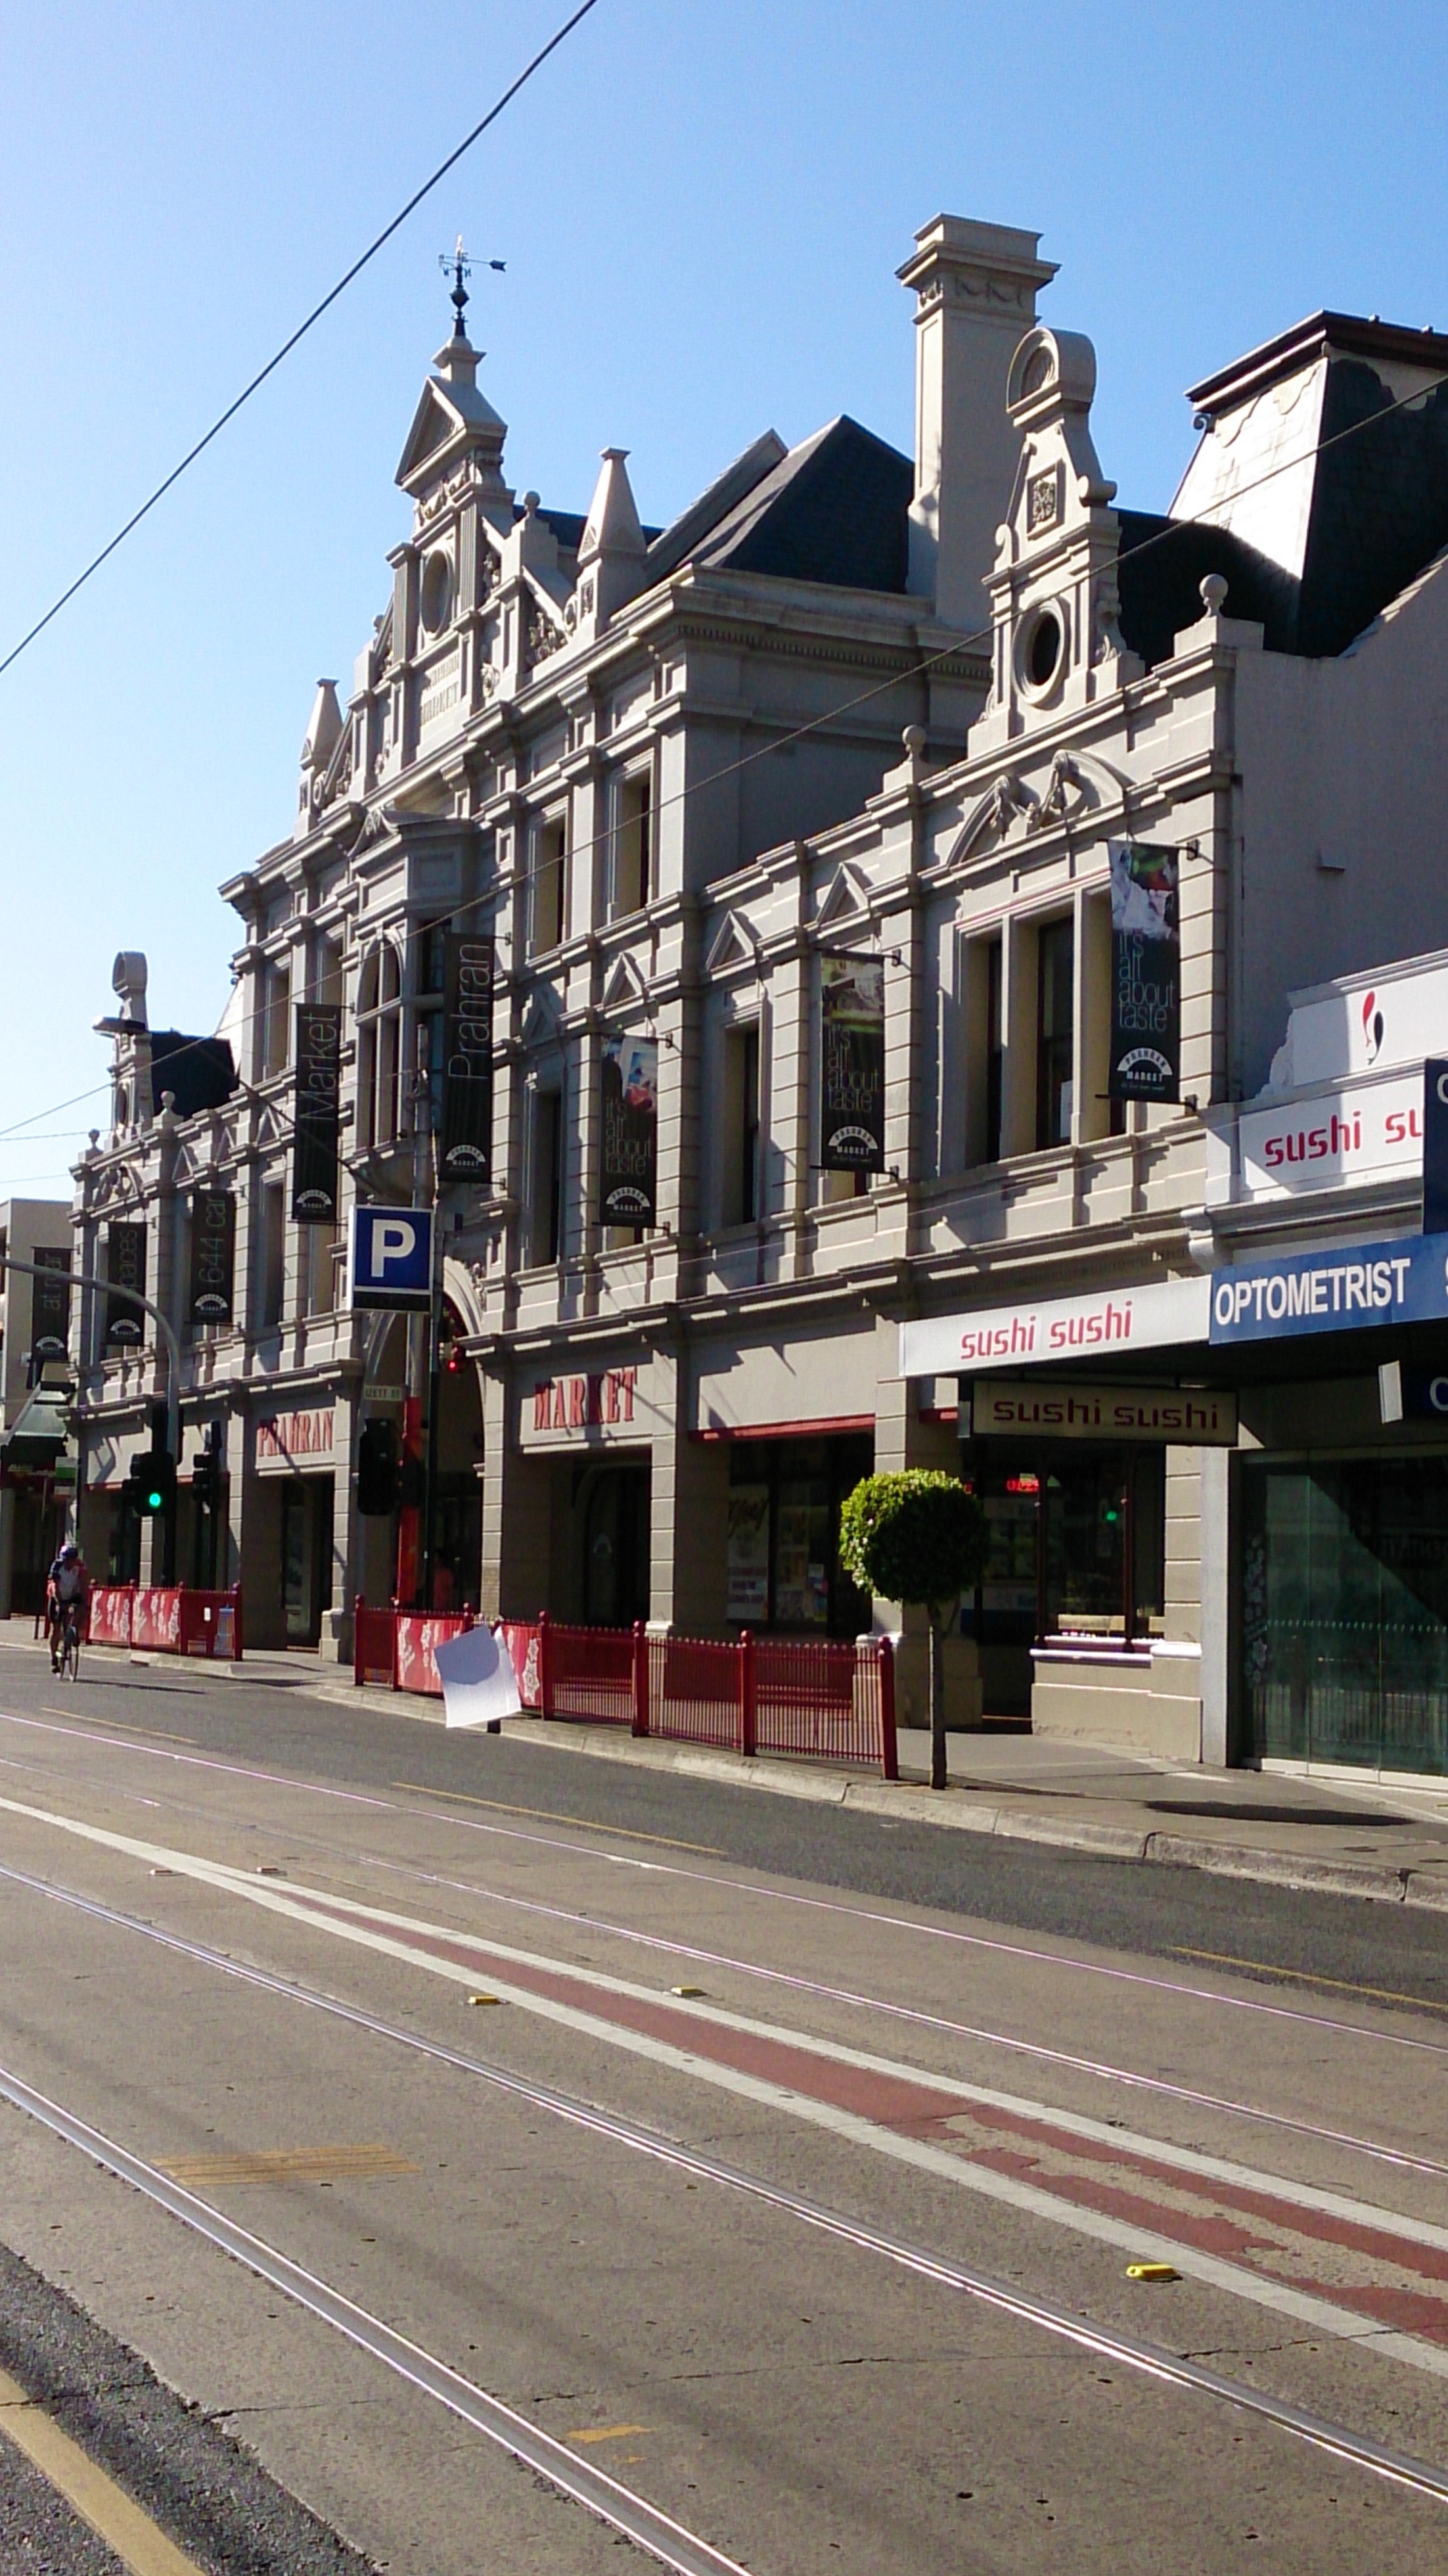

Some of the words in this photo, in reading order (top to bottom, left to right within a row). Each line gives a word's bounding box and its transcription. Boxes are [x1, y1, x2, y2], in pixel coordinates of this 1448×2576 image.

[1119, 950, 1141, 980] all
[448, 943, 490, 1079] Prahran
[1119, 977, 1176, 1009] about
[1119, 1001, 1167, 1032] taste
[300, 1012, 337, 1121] Market
[828, 1068, 878, 1092] about
[1126, 1070, 1163, 1083] MARKET
[828, 1087, 872, 1112] taste
[1265, 1111, 1361, 1167] sushi
[206, 1195, 226, 1228] car
[198, 1237, 225, 1283] 644
[371, 1218, 416, 1277] P
[1214, 1258, 1411, 1325] OPTOMETRIST
[961, 1316, 1036, 1360] sushi
[1049, 1300, 1133, 1348] sushi
[533, 1364, 638, 1431] MARKET
[993, 1397, 1100, 1425] sushi
[1114, 1402, 1217, 1429] sushi
[258, 1410, 336, 1457] PRAHRAN
